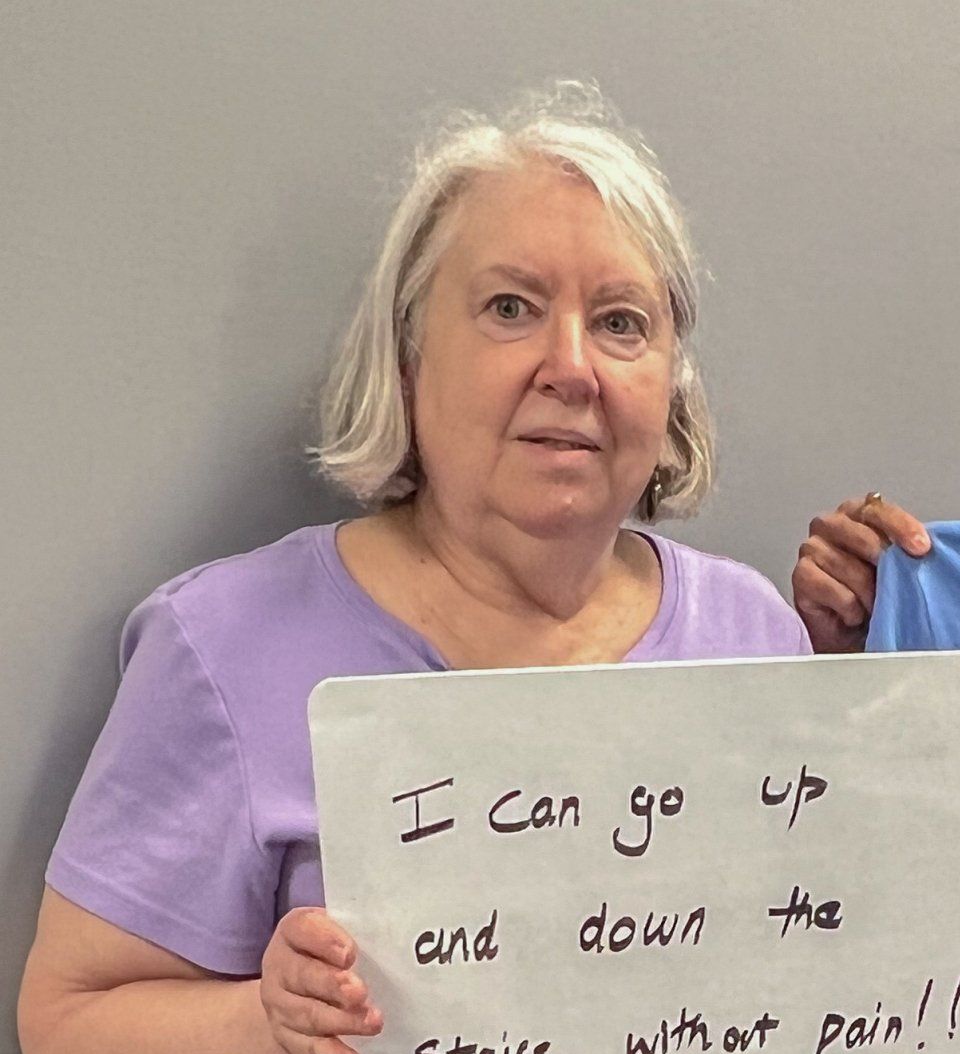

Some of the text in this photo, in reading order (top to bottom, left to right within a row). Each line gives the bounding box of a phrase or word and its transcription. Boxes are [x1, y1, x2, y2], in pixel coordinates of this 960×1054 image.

[392, 777, 455, 843] I
[612, 785, 684, 857] go
[761, 764, 828, 830] up
[414, 885, 843, 965] and down the
